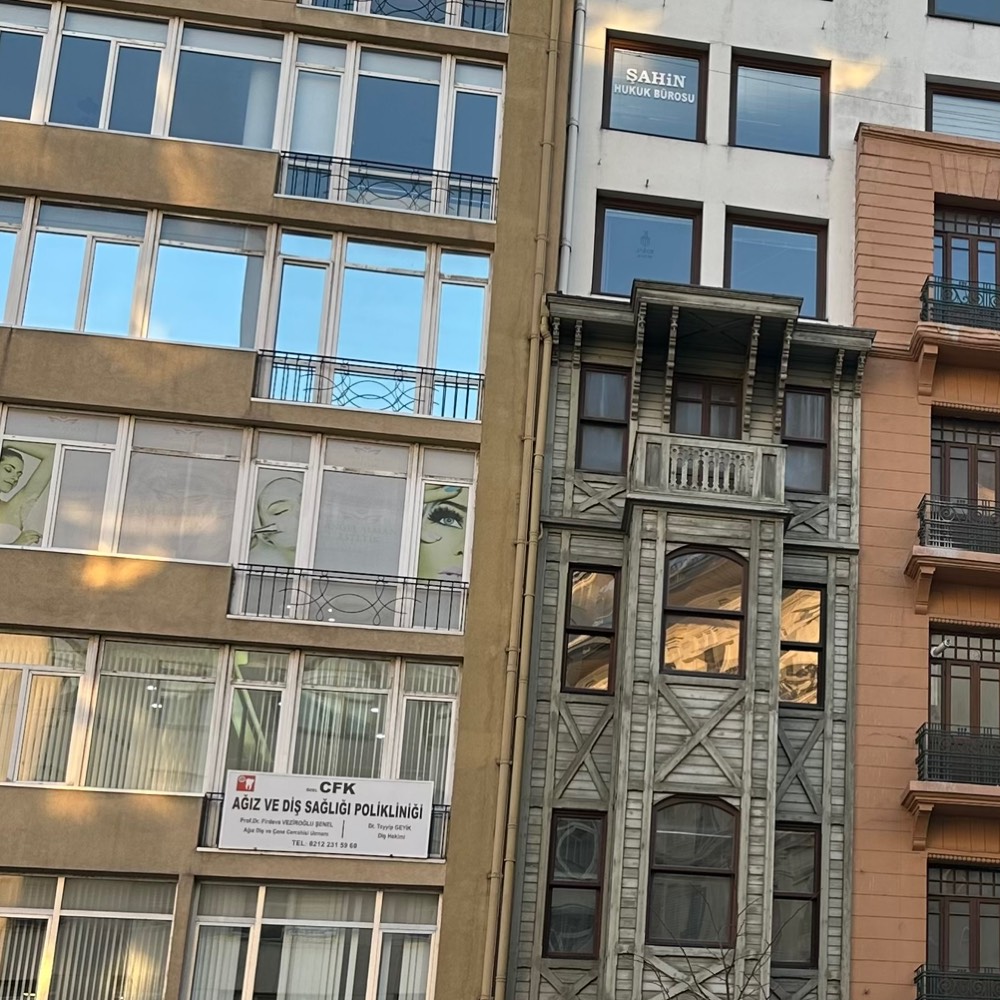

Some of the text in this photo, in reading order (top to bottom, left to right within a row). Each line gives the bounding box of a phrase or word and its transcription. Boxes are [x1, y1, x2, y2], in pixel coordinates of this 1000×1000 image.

[614, 84, 651, 98] HUKUK
[319, 781, 356, 795] CFK
[232, 794, 423, 819] AĞIZ VE DİŞ SAĞLIĞI POLİKLİNİĞİ
